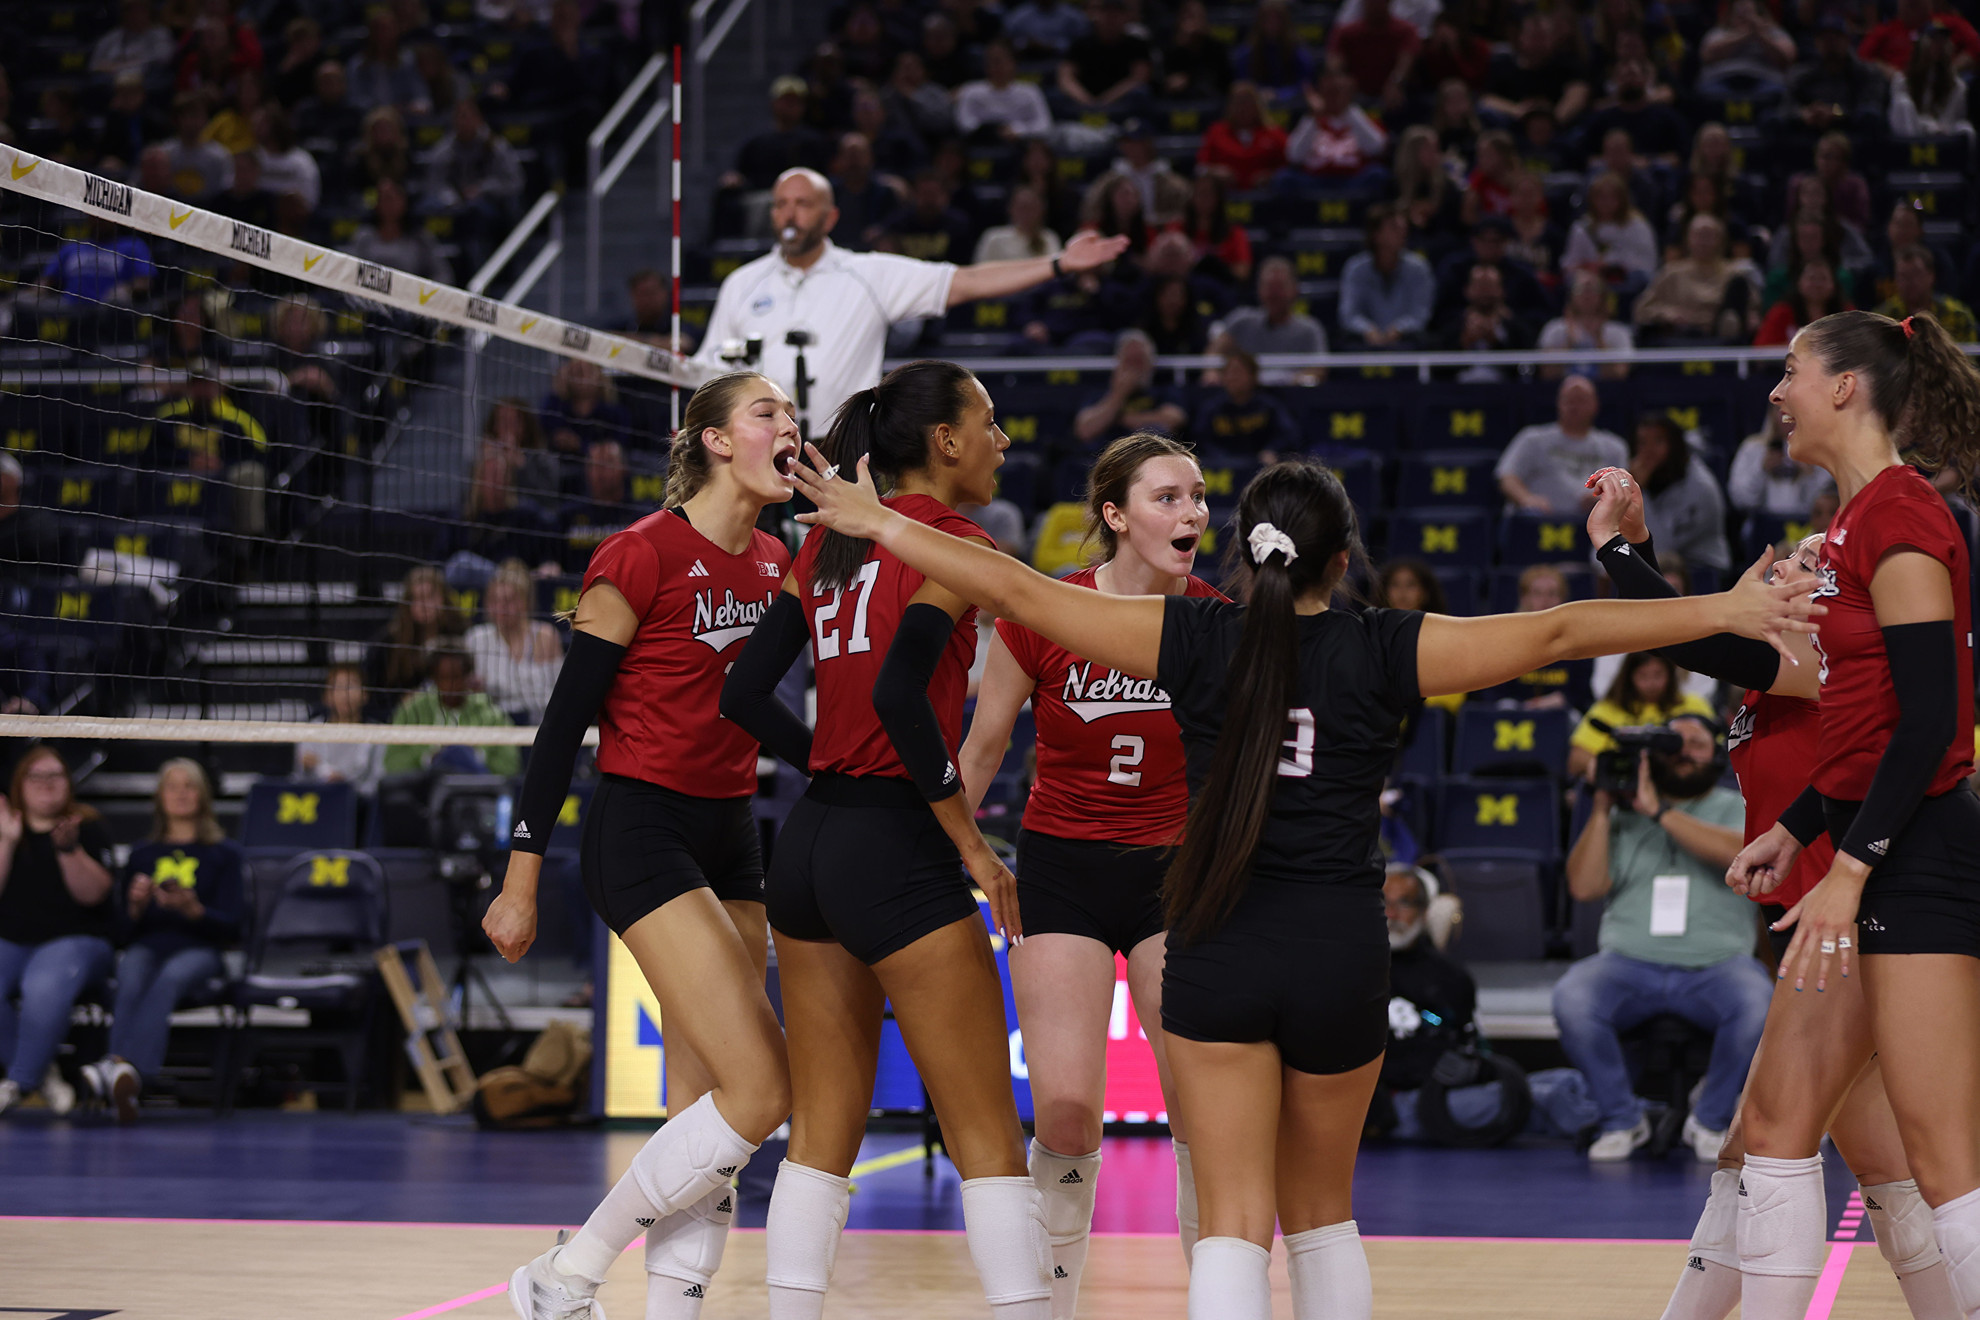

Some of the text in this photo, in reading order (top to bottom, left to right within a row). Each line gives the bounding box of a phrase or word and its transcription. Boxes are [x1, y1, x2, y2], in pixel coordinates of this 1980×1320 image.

[84, 173, 133, 217] MICHIGAN
[231, 221, 272, 261] MICHIGAN
[813, 559, 881, 662] 27
[1107, 734, 1145, 787] 2
